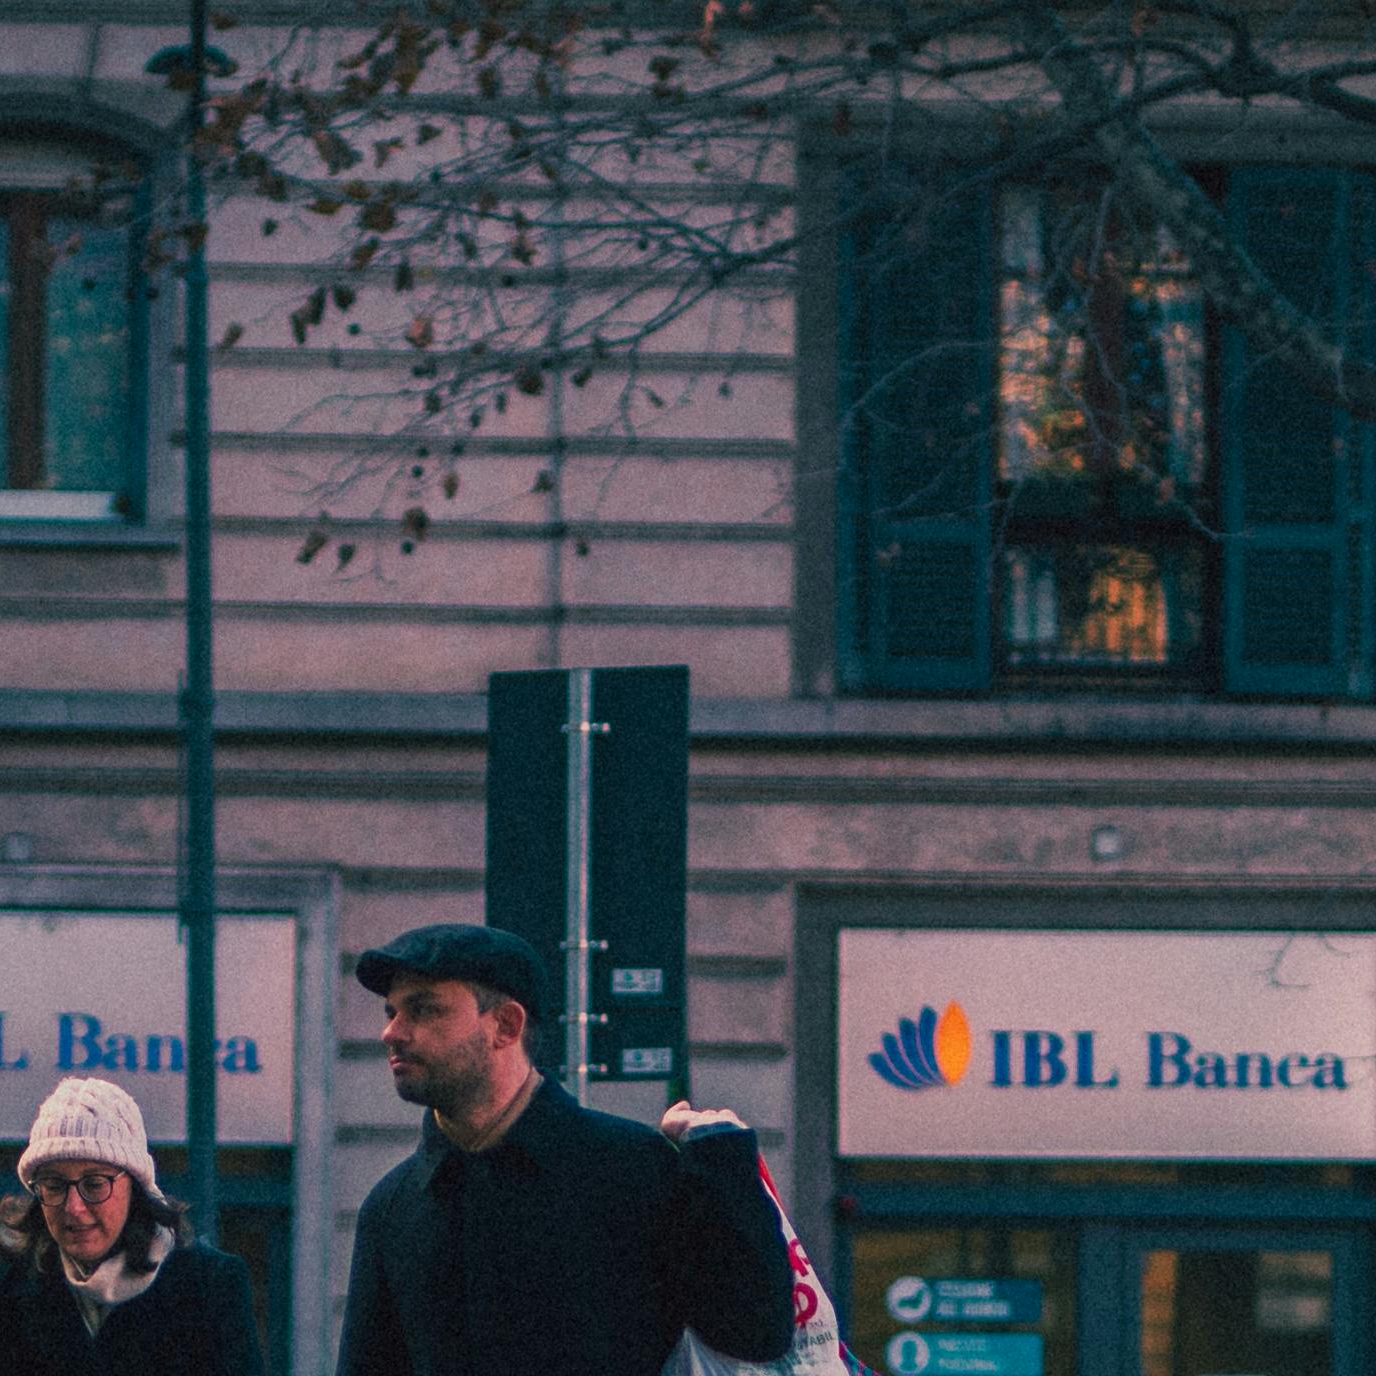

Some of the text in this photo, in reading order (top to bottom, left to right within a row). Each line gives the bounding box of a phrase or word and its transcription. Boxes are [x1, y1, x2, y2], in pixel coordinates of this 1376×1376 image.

[54, 1011, 263, 1074] Bana
[989, 1029, 1349, 1090] IBL Banca
